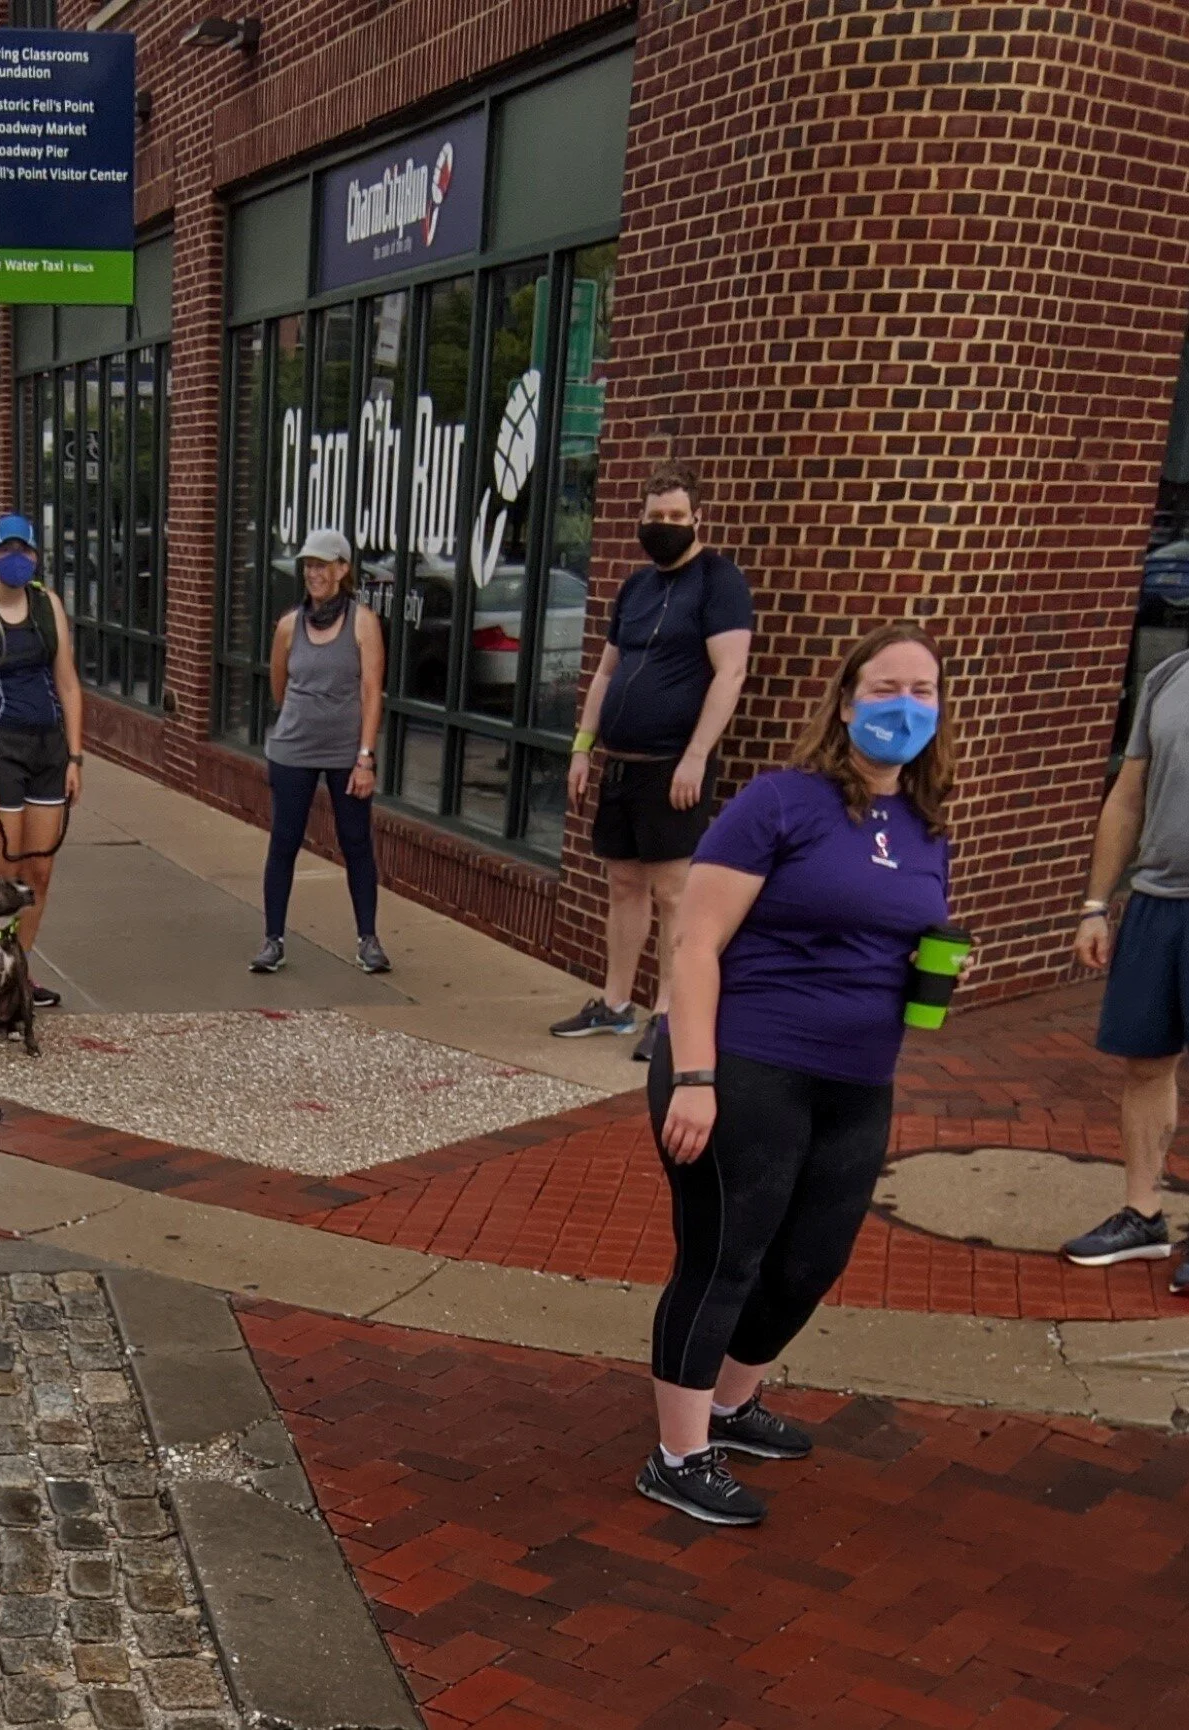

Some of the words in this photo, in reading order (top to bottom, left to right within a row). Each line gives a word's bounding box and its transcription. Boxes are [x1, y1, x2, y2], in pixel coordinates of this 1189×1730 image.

[22, 46, 89, 63] Classrooms
[33, 98, 62, 113] Fell's
[64, 99, 95, 114] Point
[46, 121, 87, 137] Market
[46, 144, 69, 158] Pier
[17, 166, 48, 180] Point
[49, 167, 87, 181] Visitor
[89, 168, 129, 182] Center
[4, 258, 39, 272] Water
[41, 259, 64, 272] Taxi
